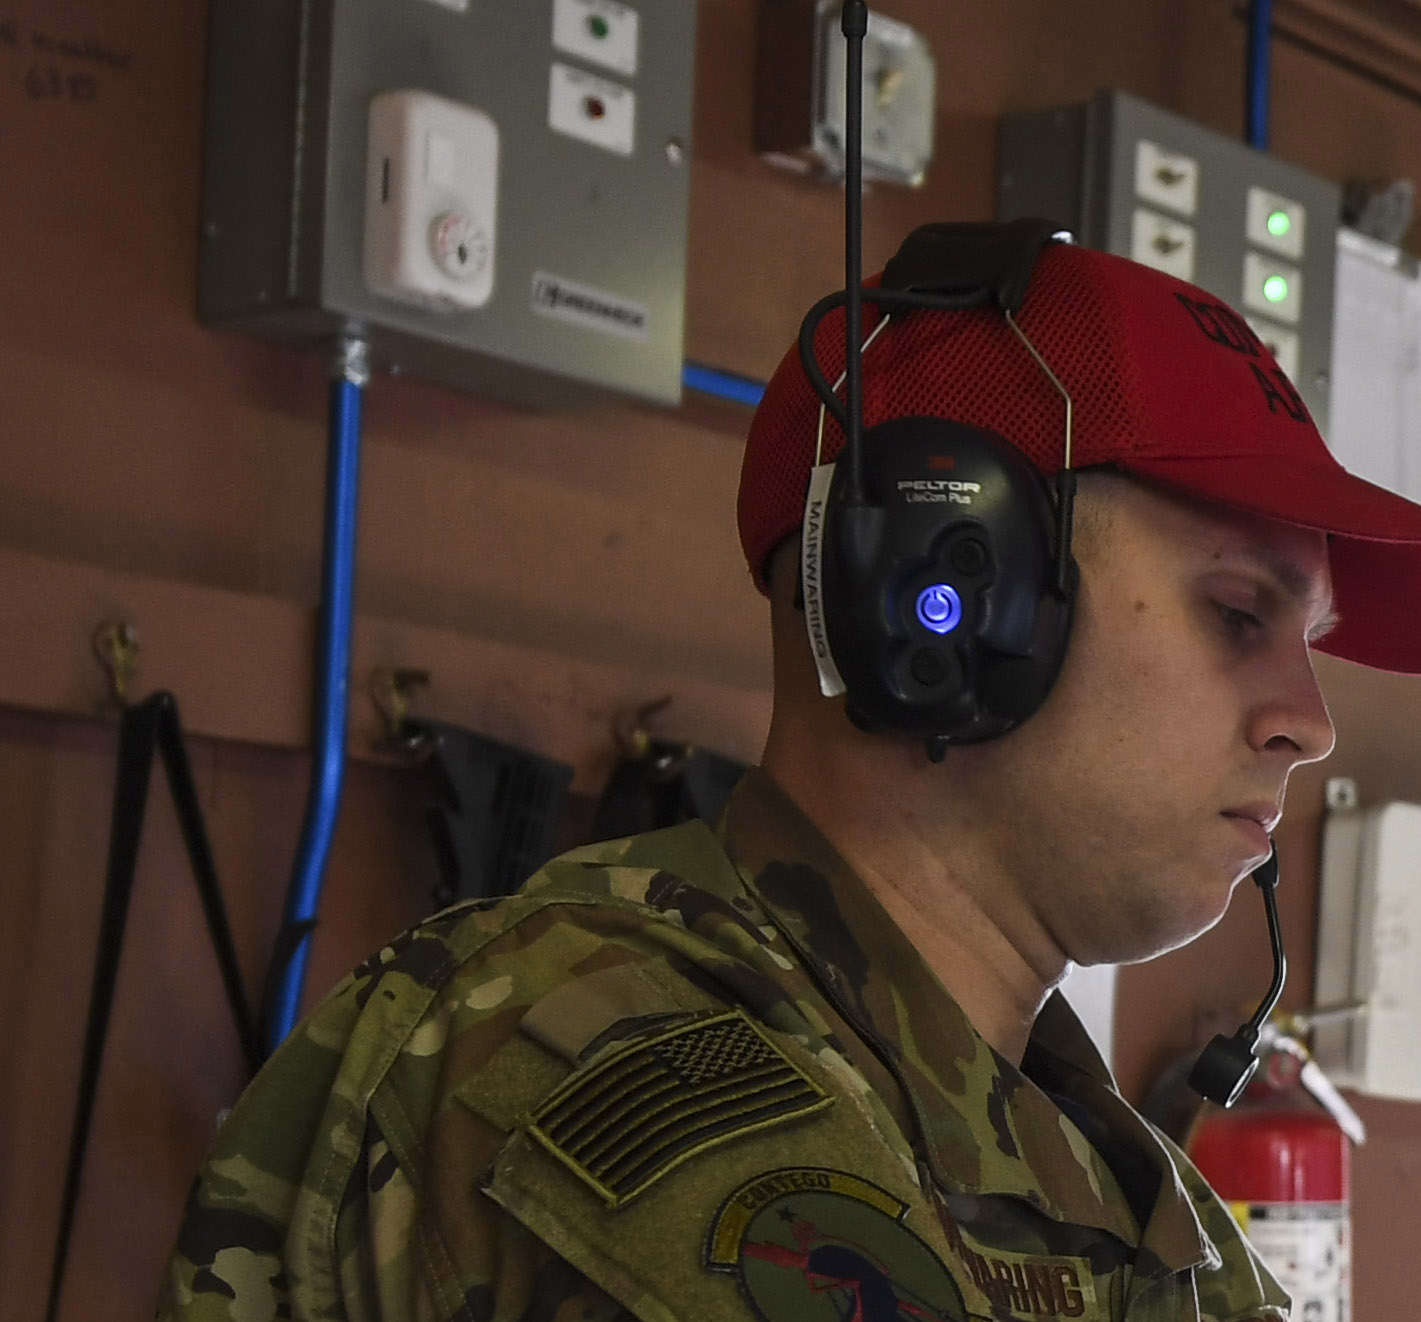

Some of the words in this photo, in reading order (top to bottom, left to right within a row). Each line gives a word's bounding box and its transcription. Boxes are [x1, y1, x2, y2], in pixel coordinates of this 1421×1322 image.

[896, 480, 982, 494] PELTOR
[806, 500, 827, 659] MAINWARING
[738, 1172, 832, 1209] CONTEGO
